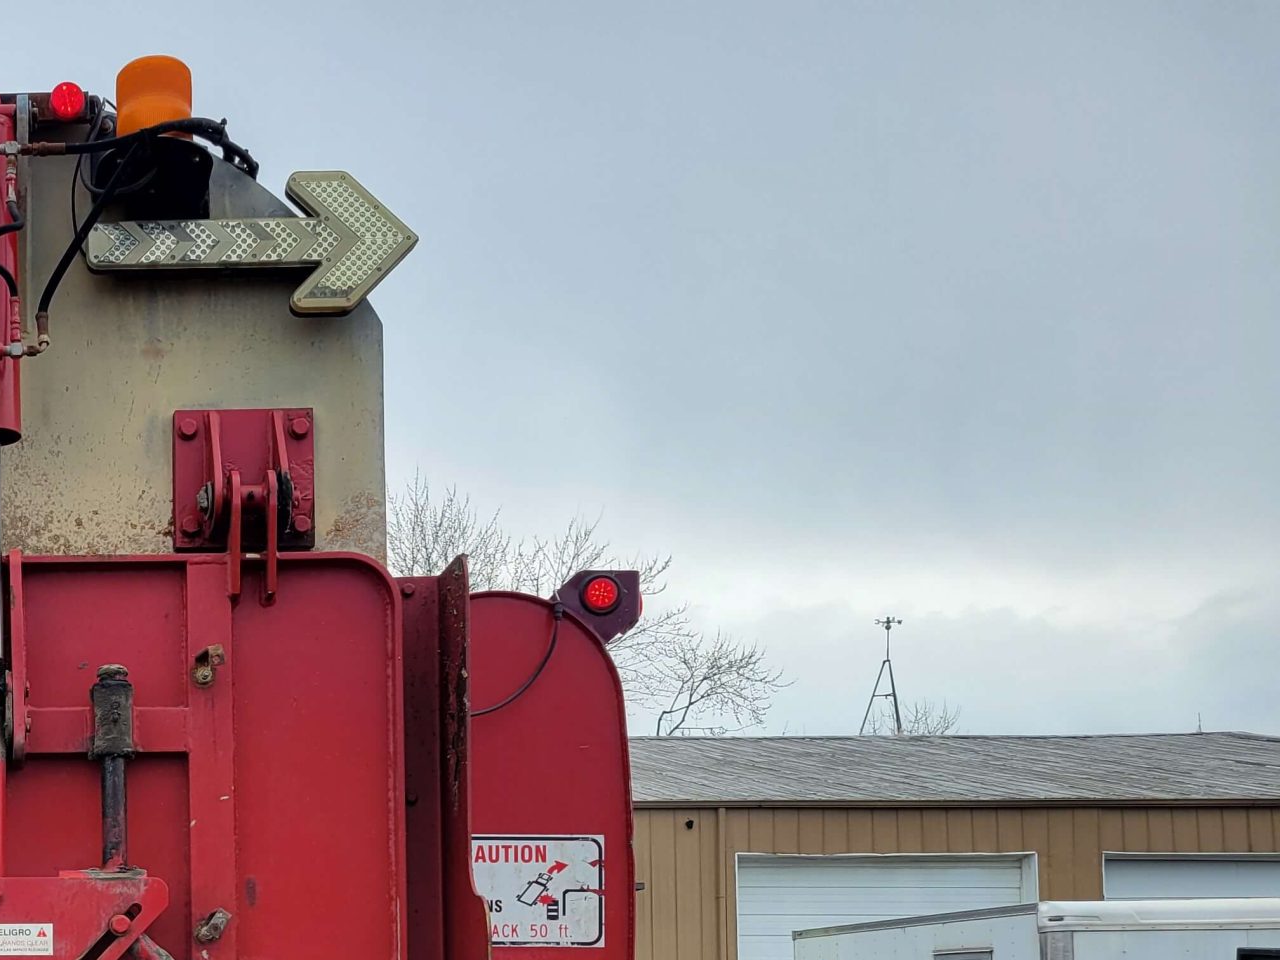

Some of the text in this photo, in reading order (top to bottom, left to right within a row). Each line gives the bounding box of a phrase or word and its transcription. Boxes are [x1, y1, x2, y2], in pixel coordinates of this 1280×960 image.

[474, 844, 547, 863] AUTION
[492, 924, 573, 938] ACK 50 ft.
